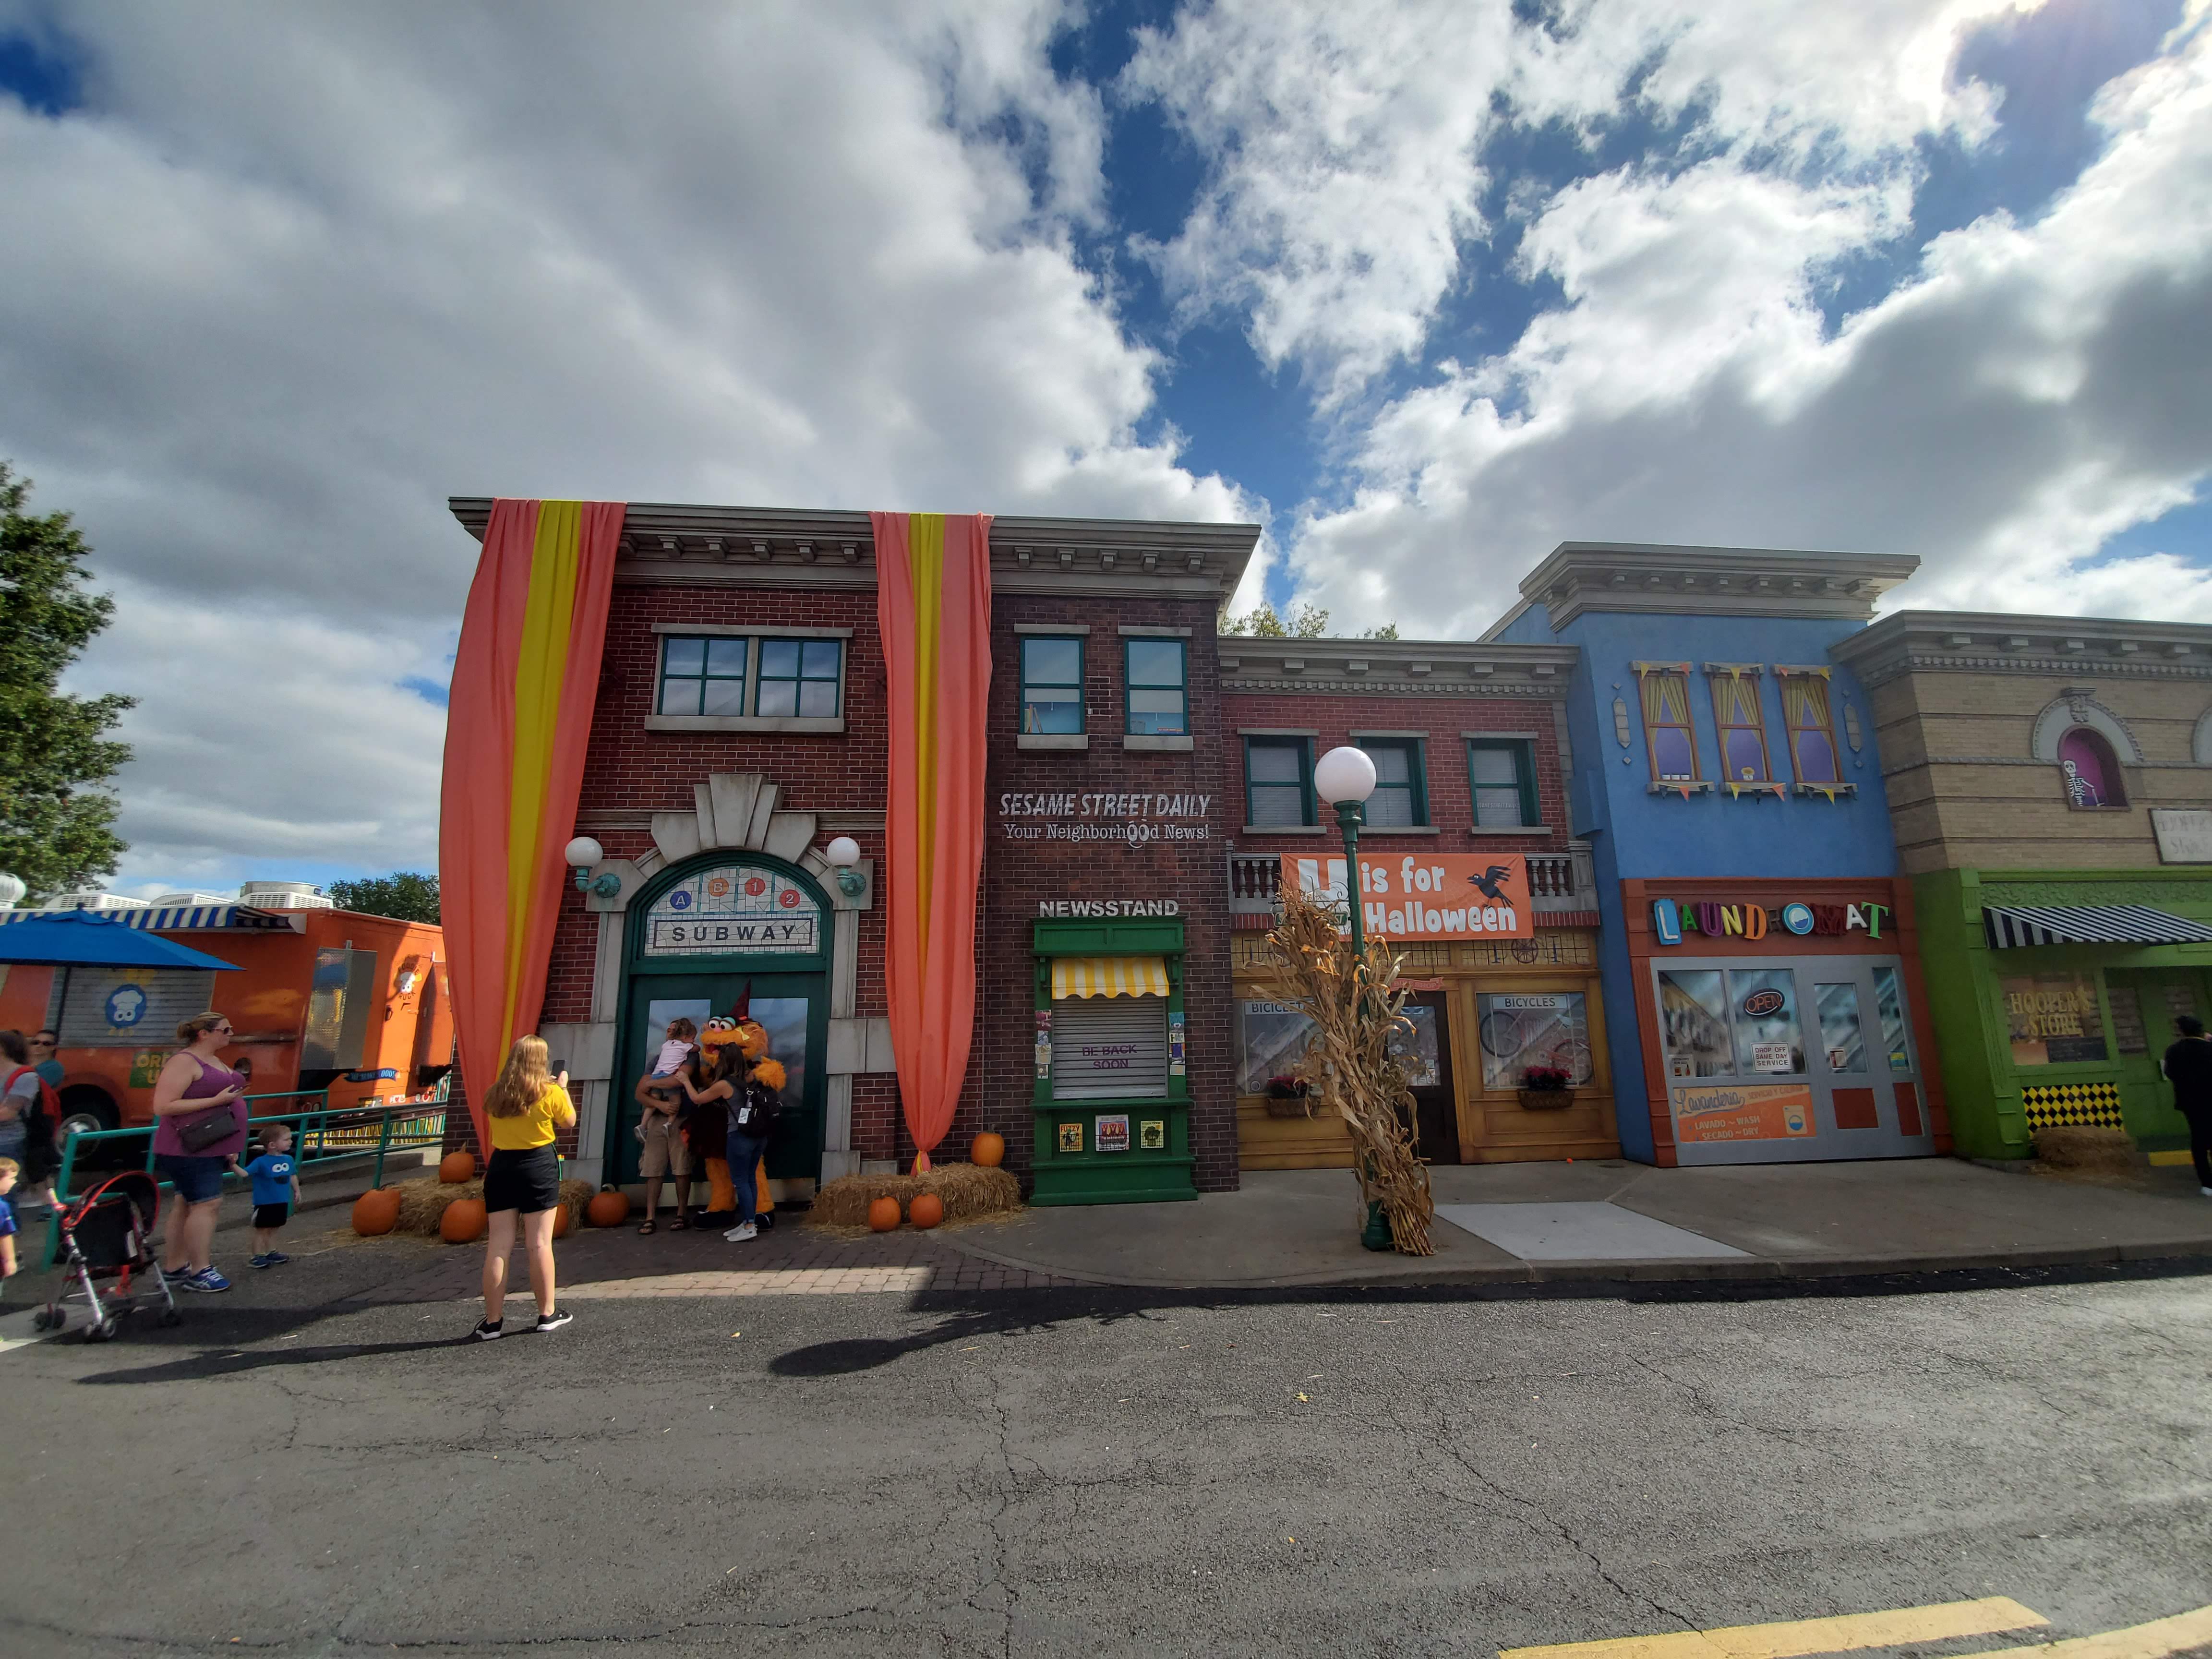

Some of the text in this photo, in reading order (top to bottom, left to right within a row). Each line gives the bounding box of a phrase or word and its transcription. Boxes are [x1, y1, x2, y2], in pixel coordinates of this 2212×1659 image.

[999, 793, 1212, 818] SESAME STREET DAILY
[1004, 824, 1042, 840] Your
[1164, 824, 1209, 840] News!
[1361, 856, 1445, 893] is for
[1040, 900, 1179, 917] NEWSSTAND
[1364, 901, 1516, 935] Halloween
[1655, 899, 1889, 943] LAUNDROMAT
[672, 925, 795, 942] SUBWAY
[1504, 998, 1556, 1007] BICYCLES
[1746, 995, 1781, 1012] OPEN
[2029, 1013, 2085, 1037] STORE
[1082, 1045, 1137, 1057] BE BACK
[1093, 1059, 1129, 1070] SOON
[1675, 1089, 1745, 1114] Lavanderia
[1695, 1119, 1726, 1130] LAVADO
[1736, 1116, 1760, 1125] WASH
[1702, 1130, 1733, 1140] SECADO
[1743, 1127, 1759, 1136] DRY
